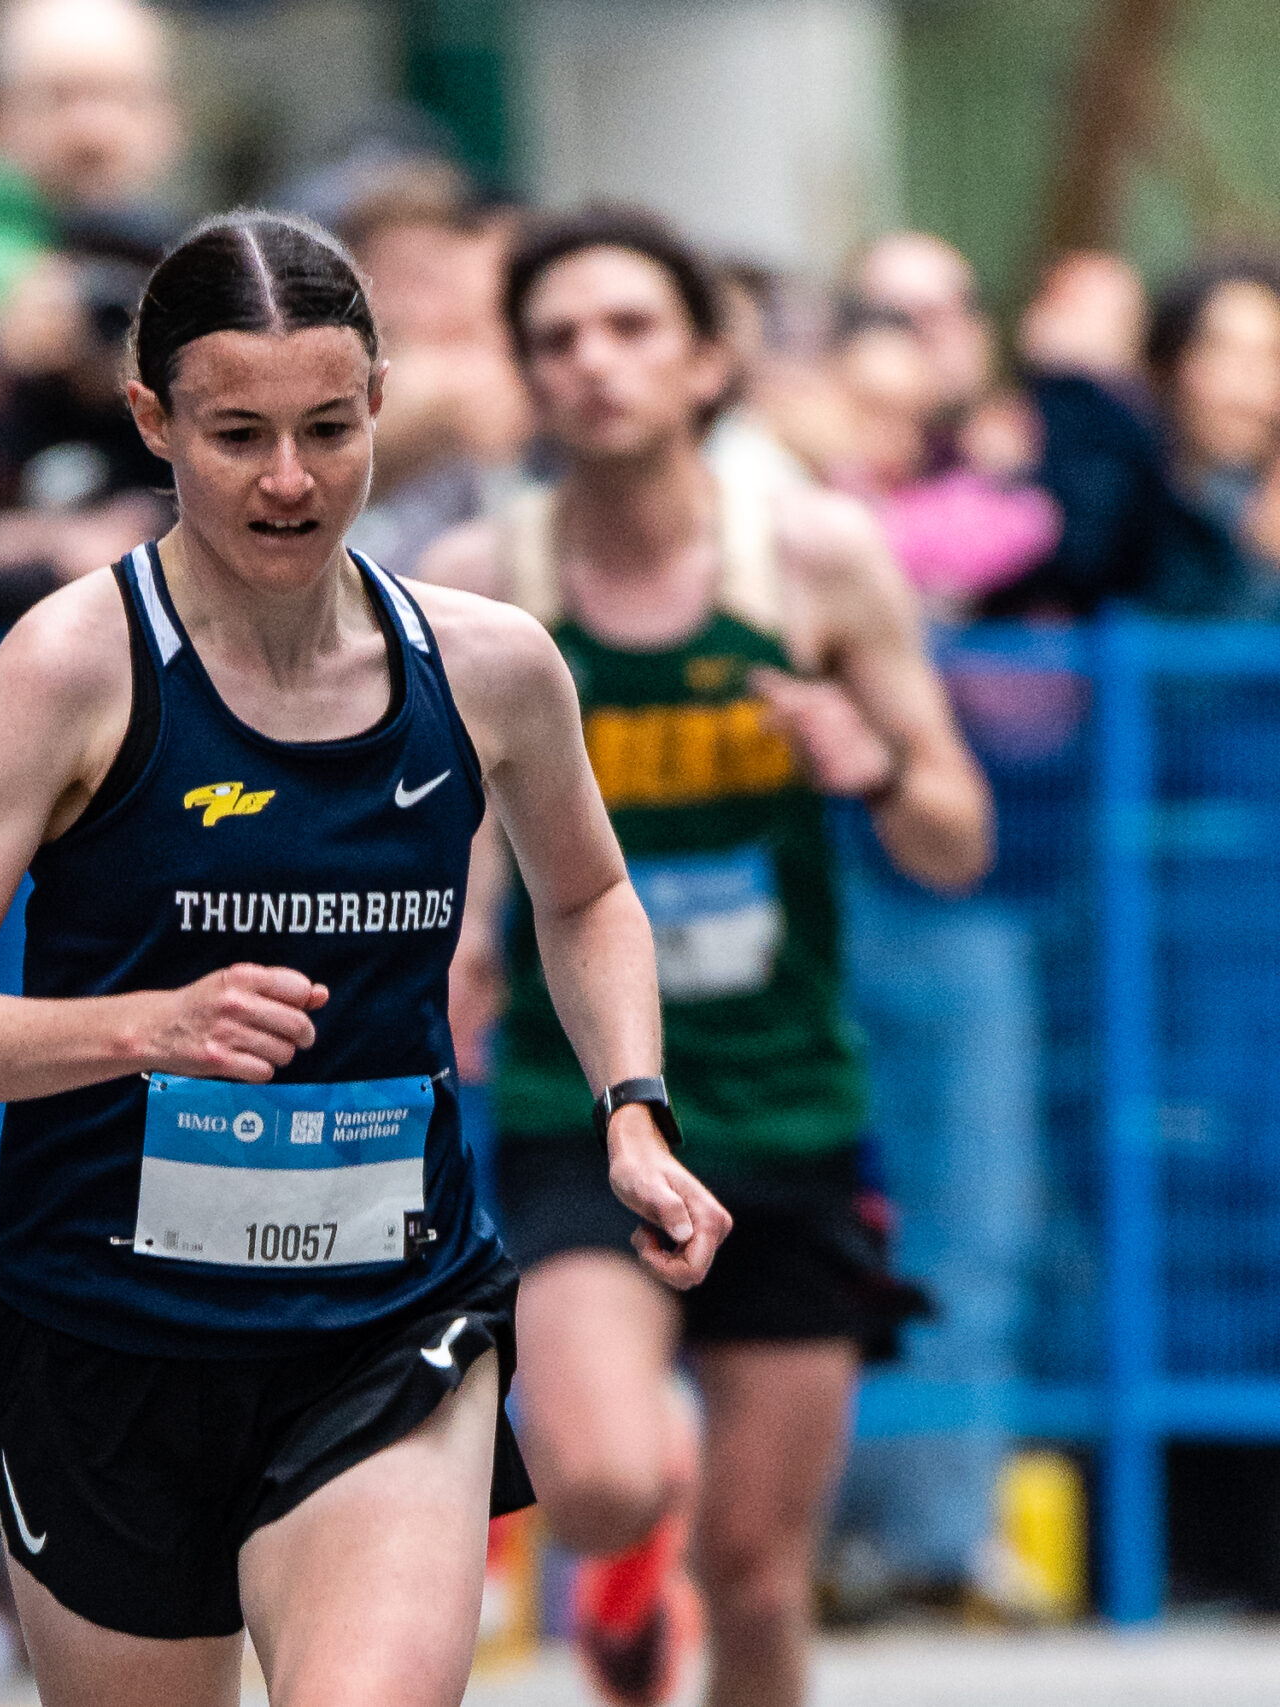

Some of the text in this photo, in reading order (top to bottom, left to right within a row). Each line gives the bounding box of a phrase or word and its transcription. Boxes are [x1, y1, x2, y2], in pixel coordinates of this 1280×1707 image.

[175, 888, 453, 933] THUNDERBIRDS
[177, 1112, 227, 1132] BMO
[335, 1108, 409, 1126] Vancouver
[332, 1123, 399, 1143] Marathon
[246, 1223, 337, 1261] 10057
